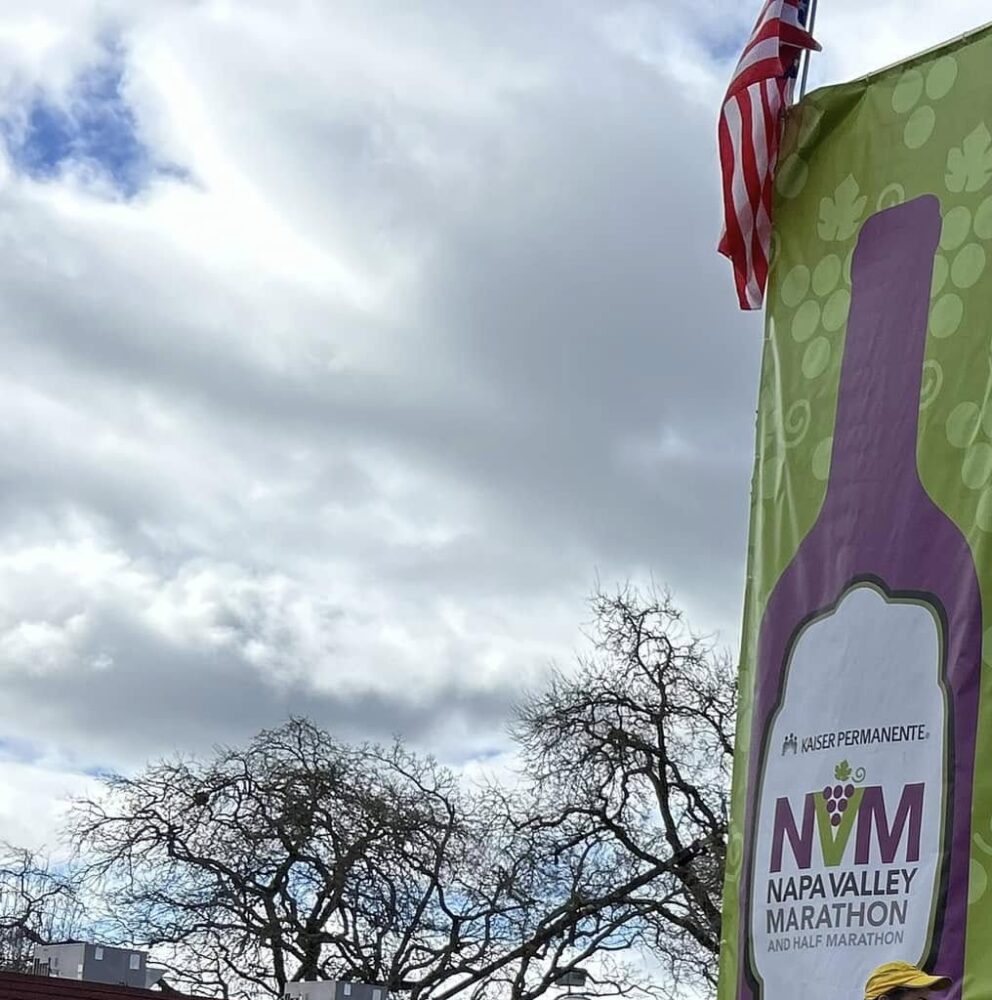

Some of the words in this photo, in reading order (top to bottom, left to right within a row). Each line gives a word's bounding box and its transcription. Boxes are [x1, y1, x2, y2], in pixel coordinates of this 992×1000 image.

[801, 733, 835, 753] KAISER
[838, 724, 926, 748] PERMANENTE
[769, 783, 926, 873] NVM
[767, 874, 826, 904] NAPA
[829, 868, 918, 897] VALLEY
[766, 900, 908, 934] MARATHON
[768, 937, 791, 952] AND
[793, 935, 822, 950] HALF
[826, 931, 904, 947] MARATHON
